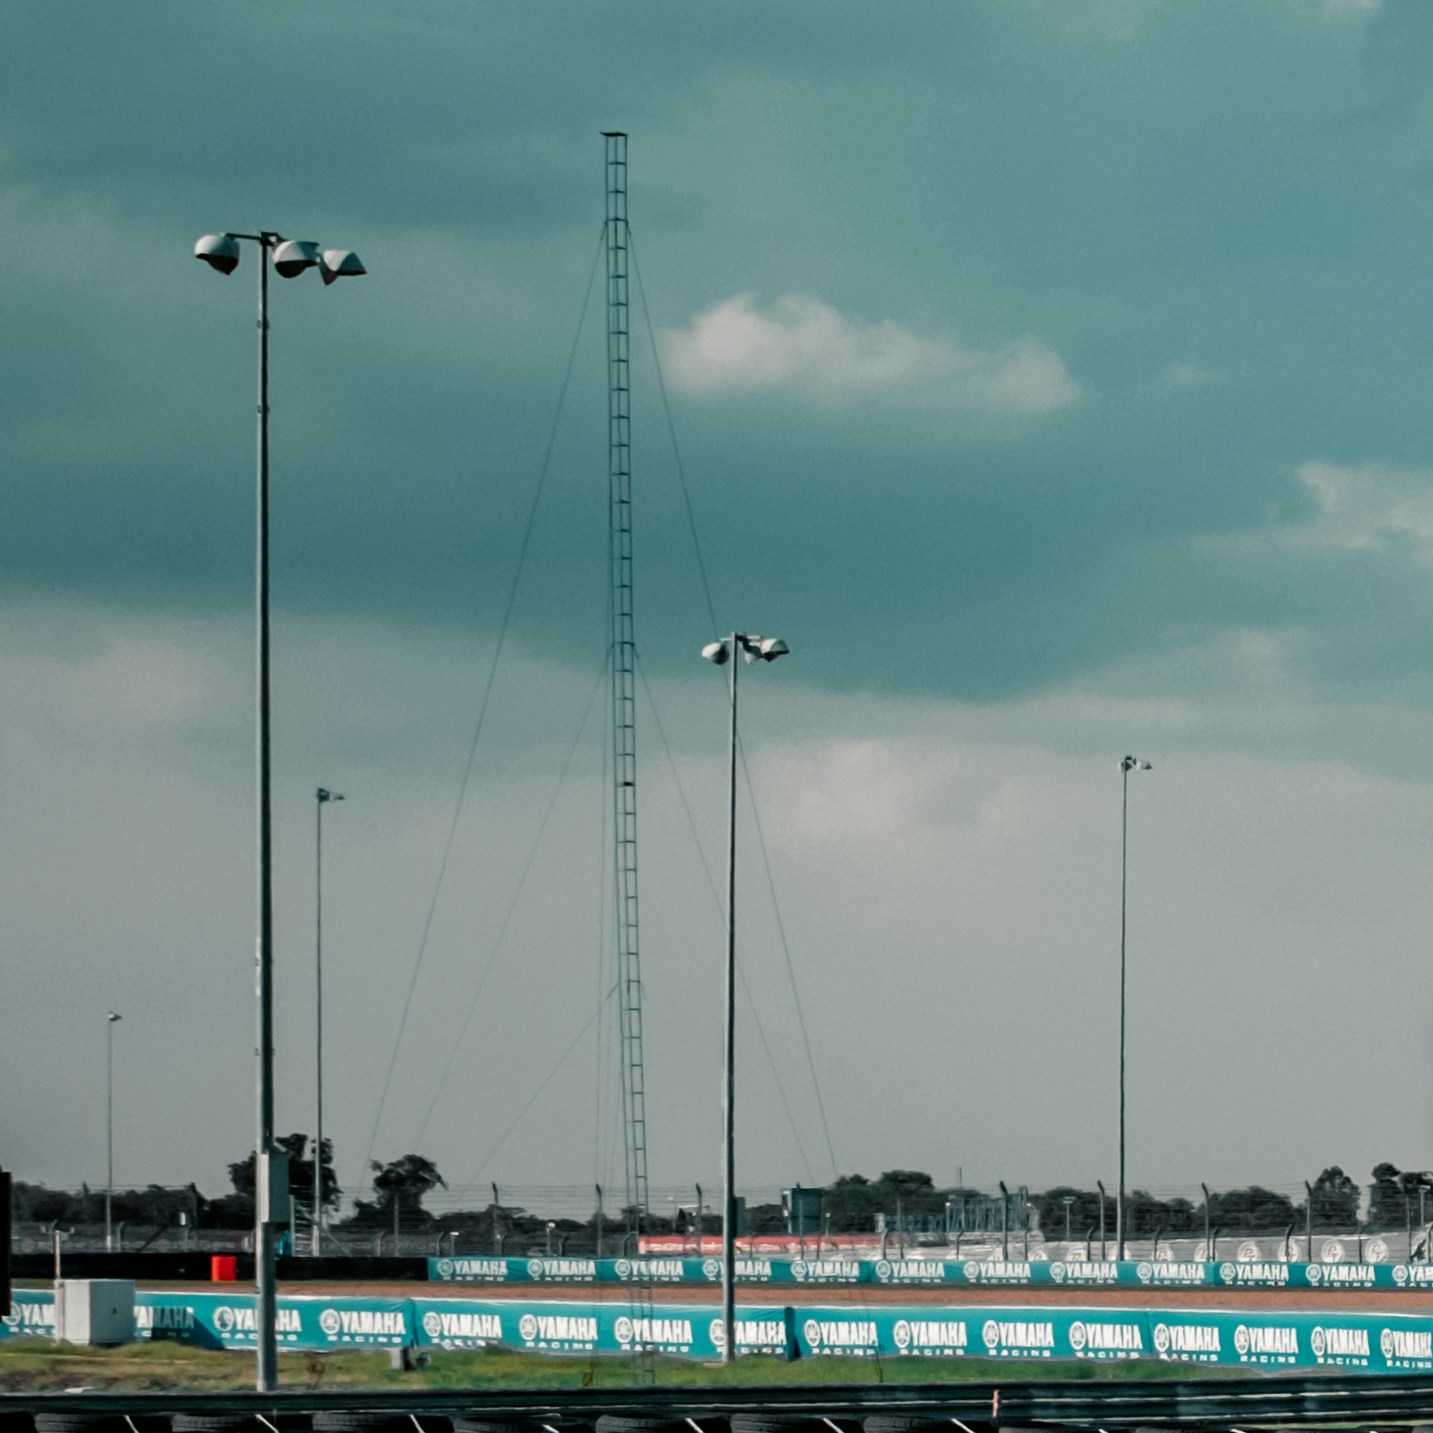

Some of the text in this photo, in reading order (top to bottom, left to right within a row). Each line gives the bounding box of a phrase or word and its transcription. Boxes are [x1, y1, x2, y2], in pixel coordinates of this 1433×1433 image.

[454, 1261, 508, 1274] YAMAHA
[544, 1261, 596, 1275] YAMAHA
[632, 1261, 683, 1275] YAMAHA
[719, 1259, 771, 1275] YMAHA
[806, 1260, 860, 1276] YAMAHA
[892, 1262, 944, 1277] YAMAHA
[978, 1261, 1031, 1277] YAMAHA
[1066, 1263, 1118, 1278] YAMAHA
[1153, 1264, 1205, 1278] YAMAHA
[1236, 1264, 1289, 1279] YAMAHA
[1322, 1266, 1375, 1280] YAMAHA
[340, 1312, 406, 1334] YAMAHA
[440, 1314, 502, 1337] YAMAHA
[536, 1317, 598, 1340] YAMAHA
[631, 1320, 692, 1343] YAMAHA
[819, 1322, 878, 1345] YAMAHA
[910, 1322, 967, 1346] YAMAHA
[998, 1323, 1055, 1347] YAMAHA
[1085, 1324, 1143, 1349] YAMAHA
[1169, 1326, 1220, 1351] YAMAHA
[1248, 1328, 1298, 1353] YAMAHA
[1325, 1329, 1370, 1355] YAMAHA
[1392, 1332, 1432, 1357] YAMAHA
